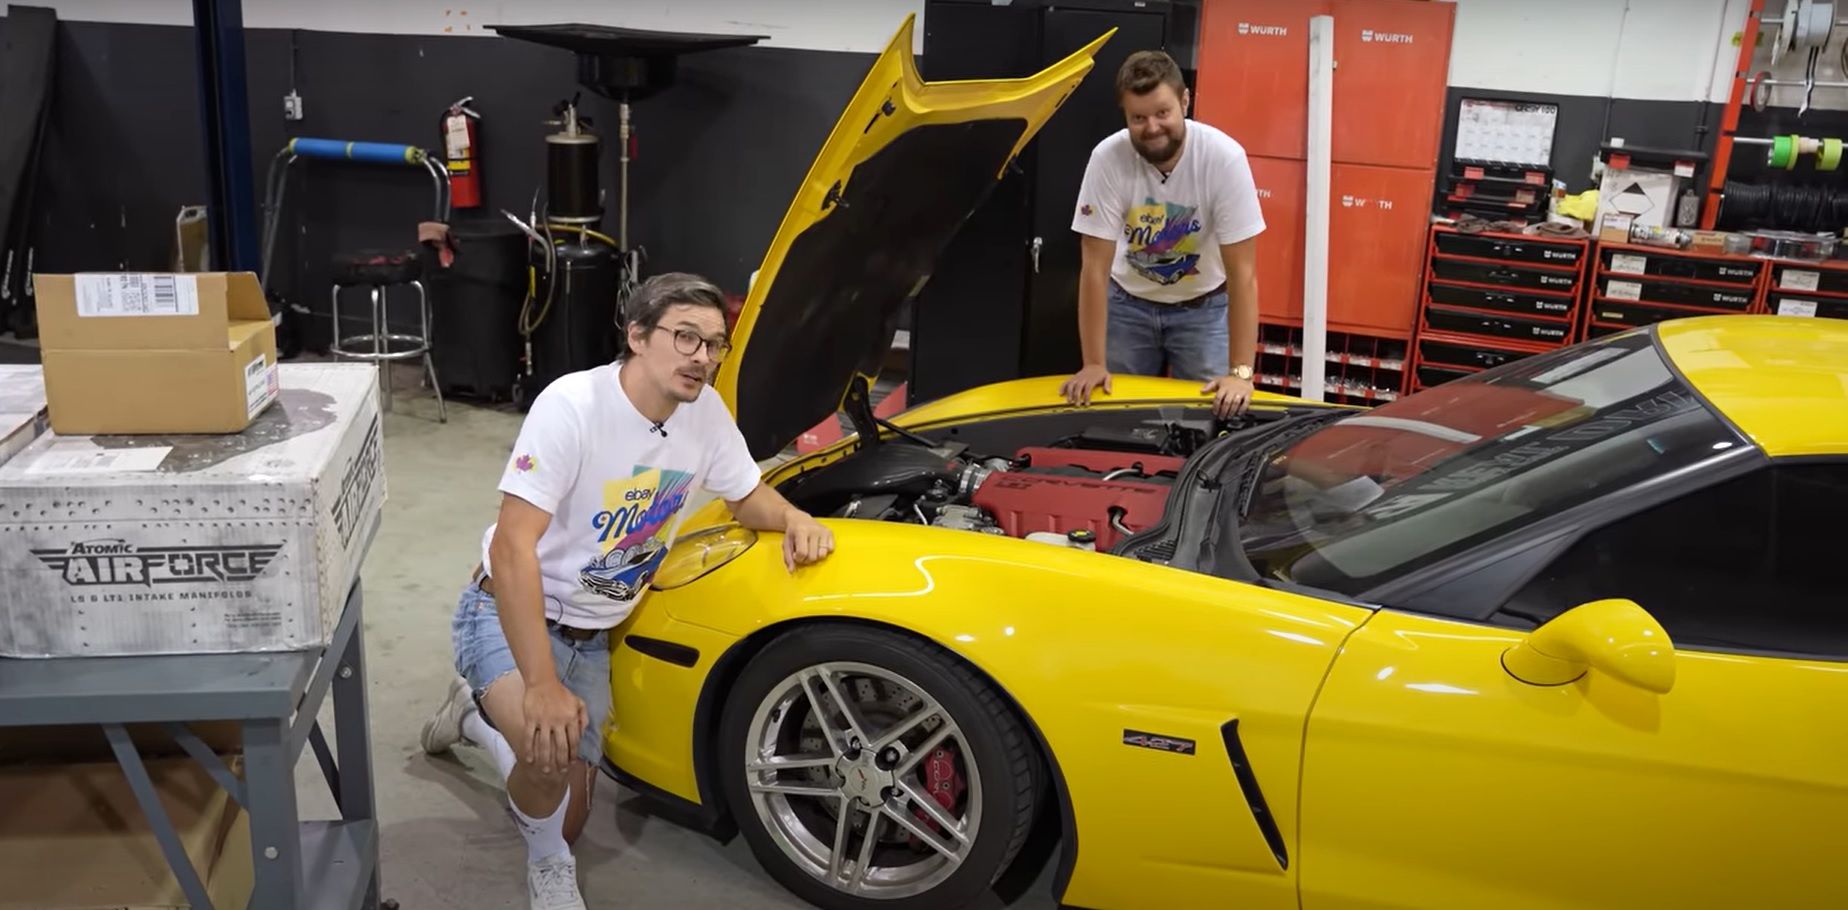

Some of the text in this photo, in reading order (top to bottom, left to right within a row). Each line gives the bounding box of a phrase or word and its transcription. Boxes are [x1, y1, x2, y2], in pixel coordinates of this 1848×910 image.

[625, 488, 657, 502] ebay
[592, 490, 689, 543] Motor
[129, 592, 174, 601] INTAKE
[180, 590, 252, 600] MANIFOLDS
